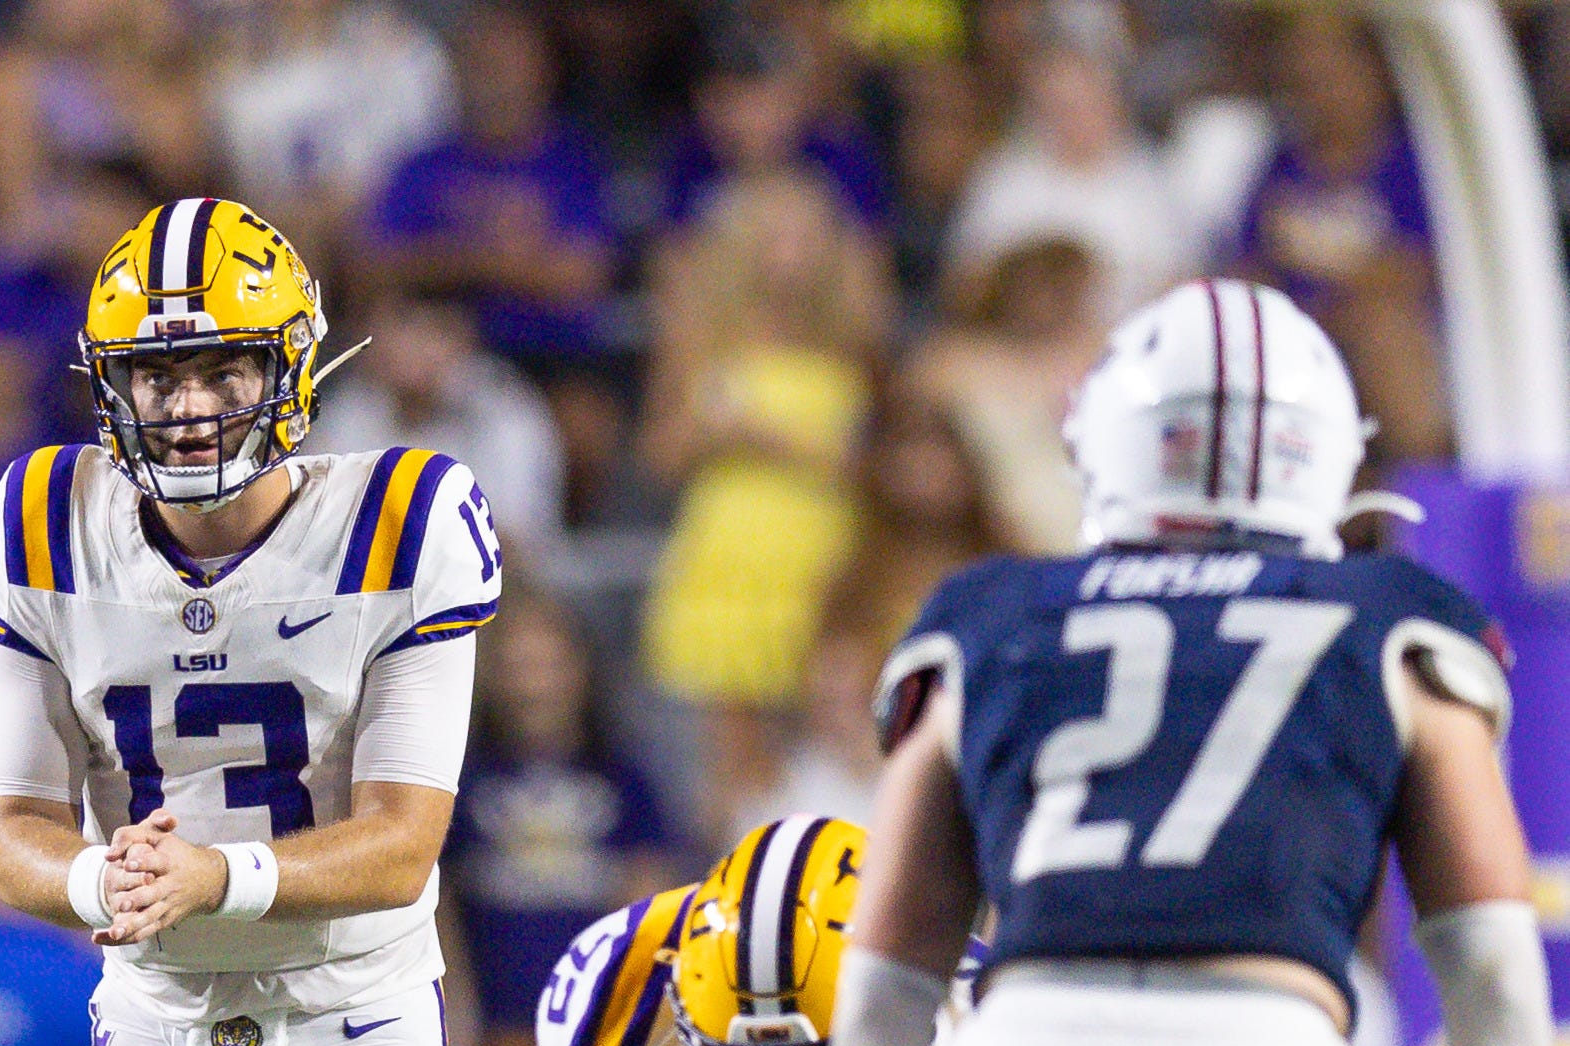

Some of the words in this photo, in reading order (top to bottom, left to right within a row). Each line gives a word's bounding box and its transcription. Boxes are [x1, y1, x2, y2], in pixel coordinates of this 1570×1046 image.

[173, 653, 227, 672] LSU
[1010, 599, 1356, 884] 27
[102, 680, 316, 841] 13
